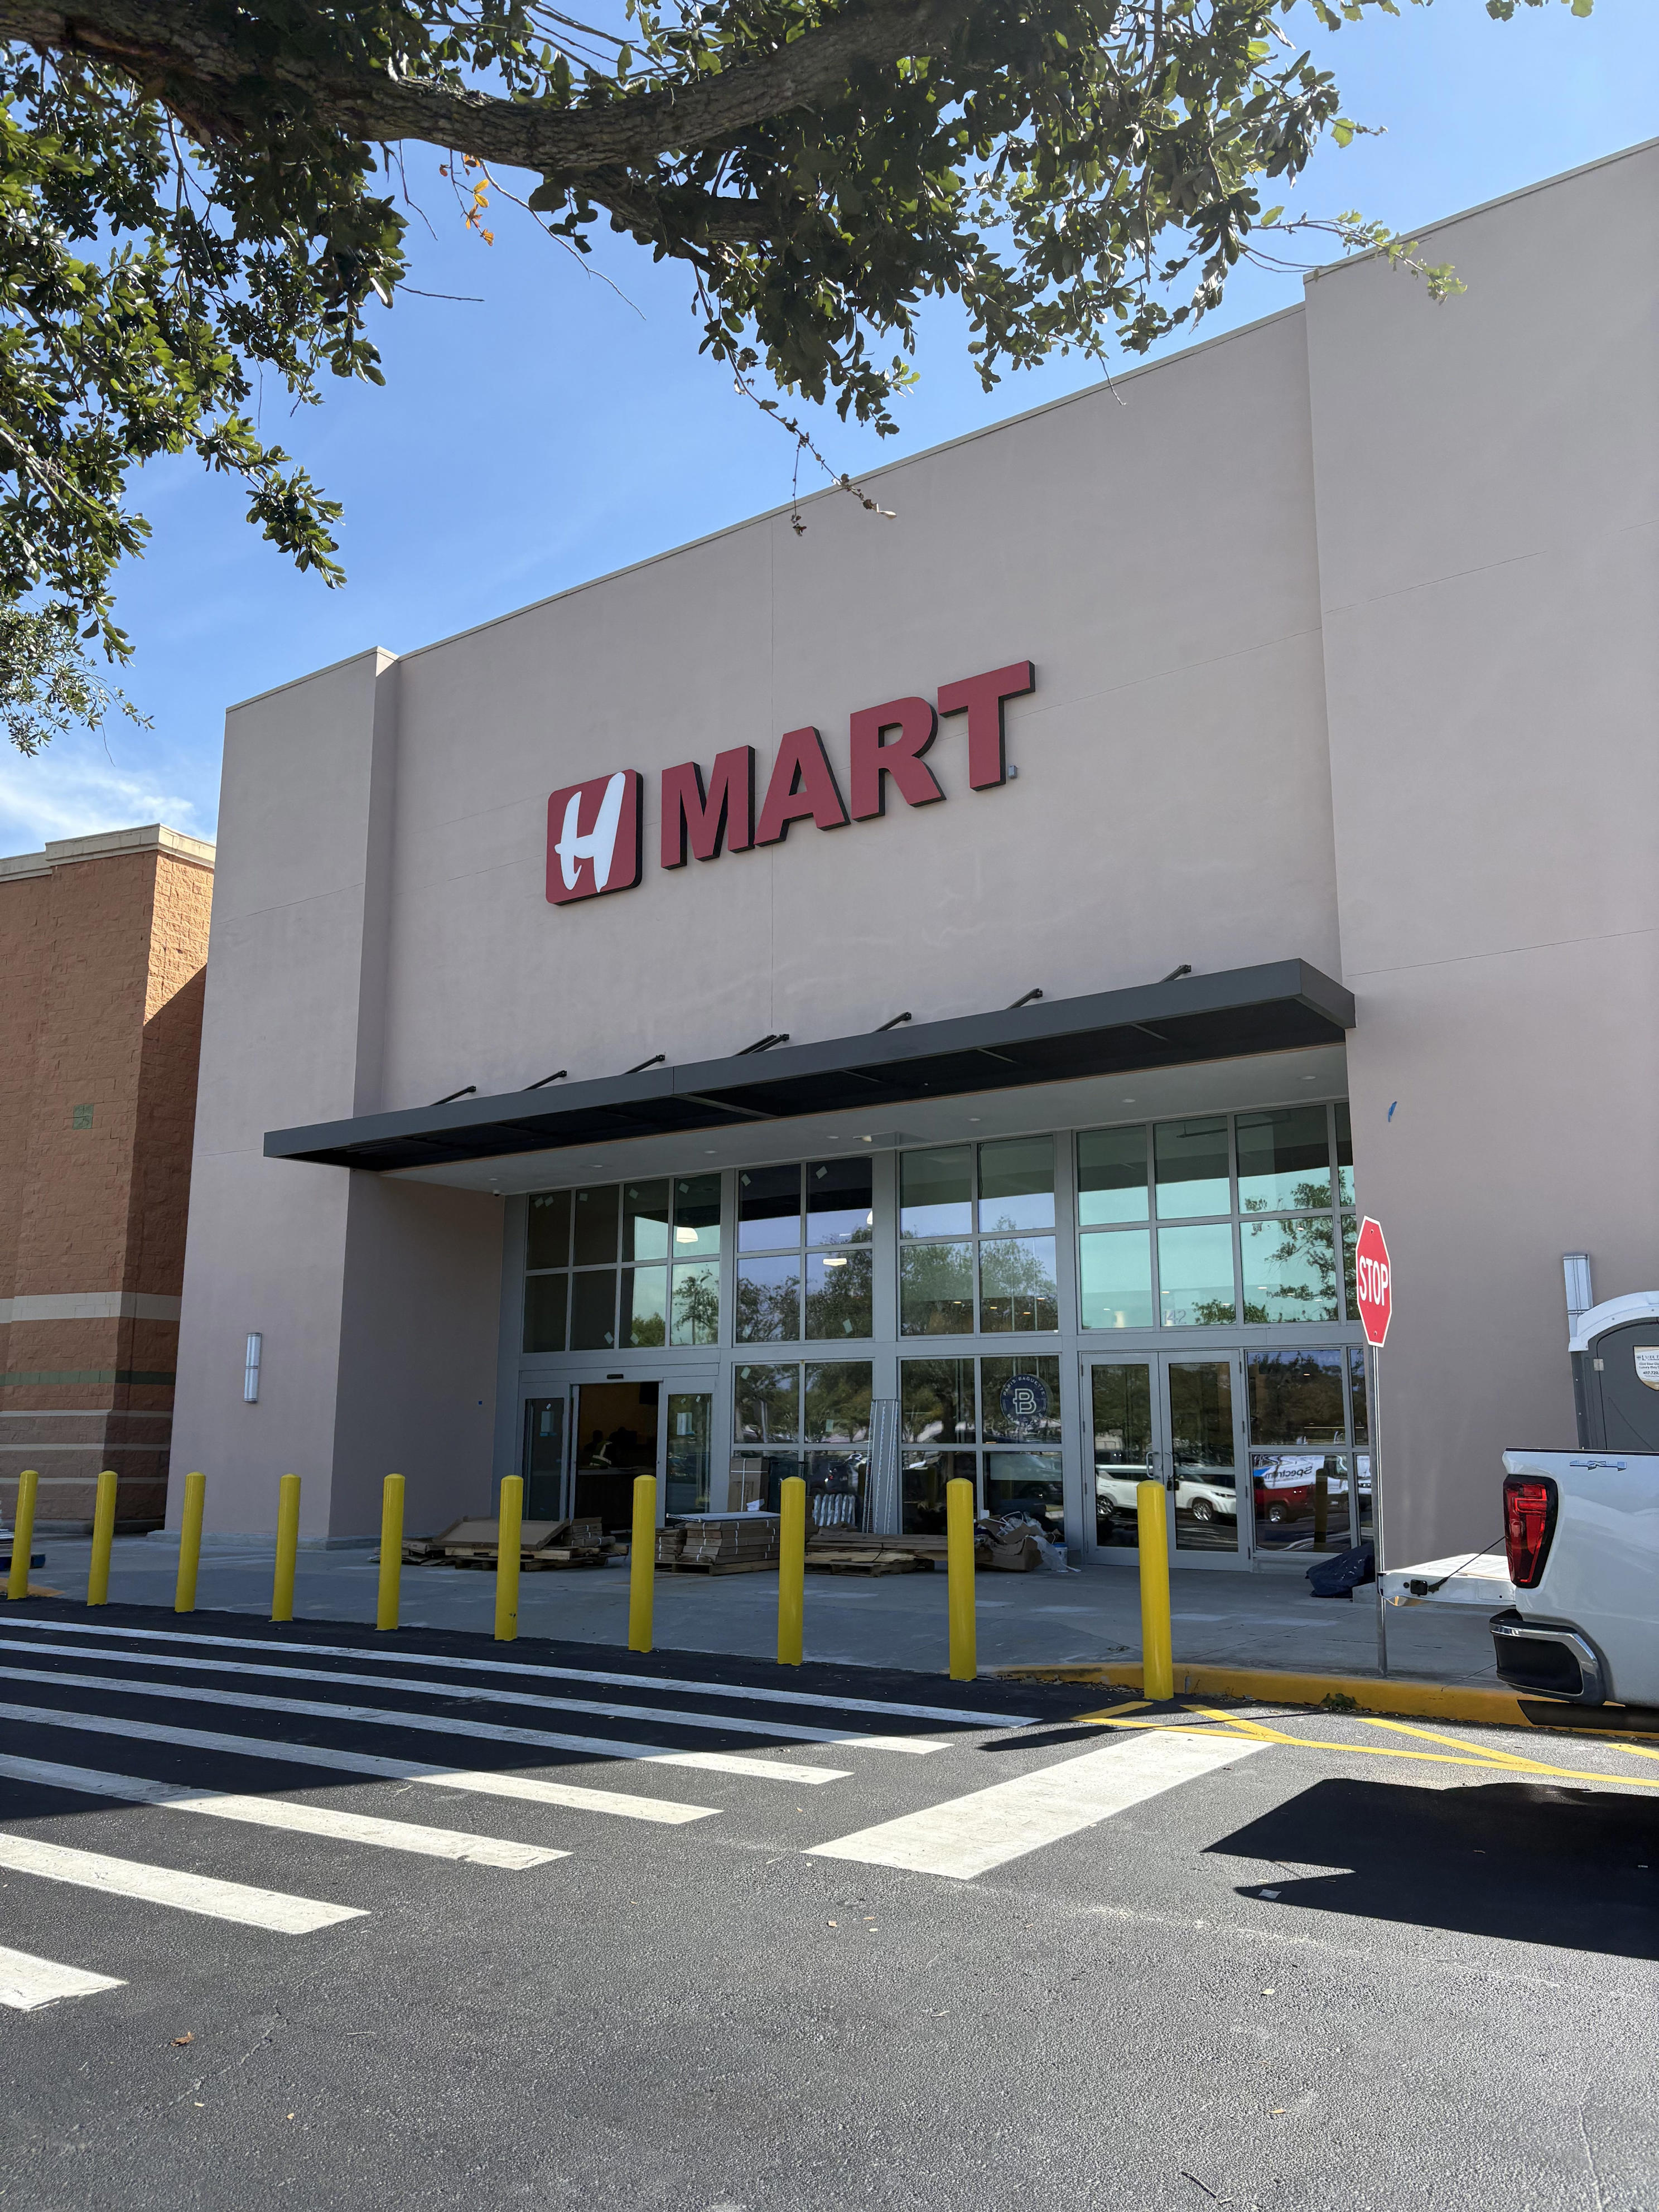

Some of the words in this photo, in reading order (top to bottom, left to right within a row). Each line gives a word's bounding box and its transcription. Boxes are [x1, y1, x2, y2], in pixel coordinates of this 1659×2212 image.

[554, 771, 626, 893] H
[660, 660, 1035, 871] MART
[1359, 1255, 1389, 1306] STOP
[1003, 1379, 1016, 1396] PARIS
[1018, 1376, 1046, 1396] BAGUETTE
